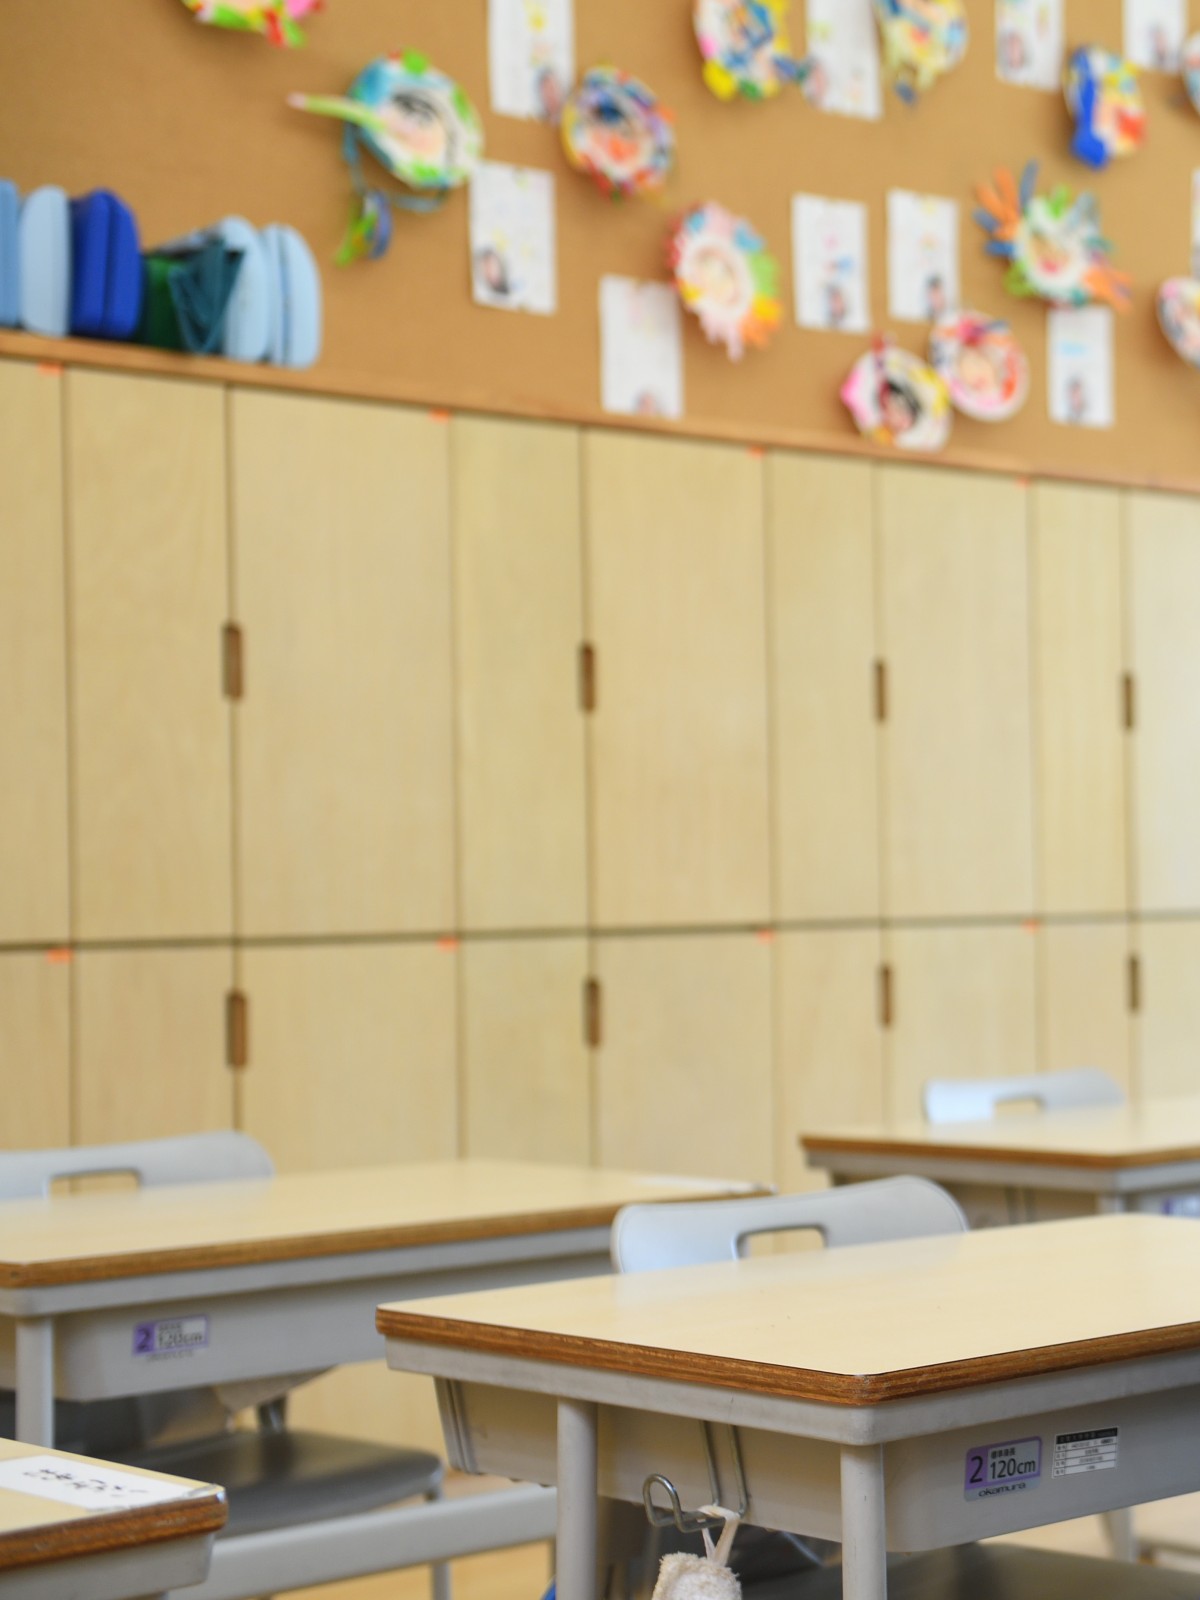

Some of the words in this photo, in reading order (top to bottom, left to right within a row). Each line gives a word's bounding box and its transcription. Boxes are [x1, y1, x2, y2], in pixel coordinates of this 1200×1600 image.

[137, 1327, 151, 1353] 2
[969, 1455, 984, 1484] 2
[990, 1458, 1036, 1480] 120cm
[978, 1482, 1026, 1497] okamura
